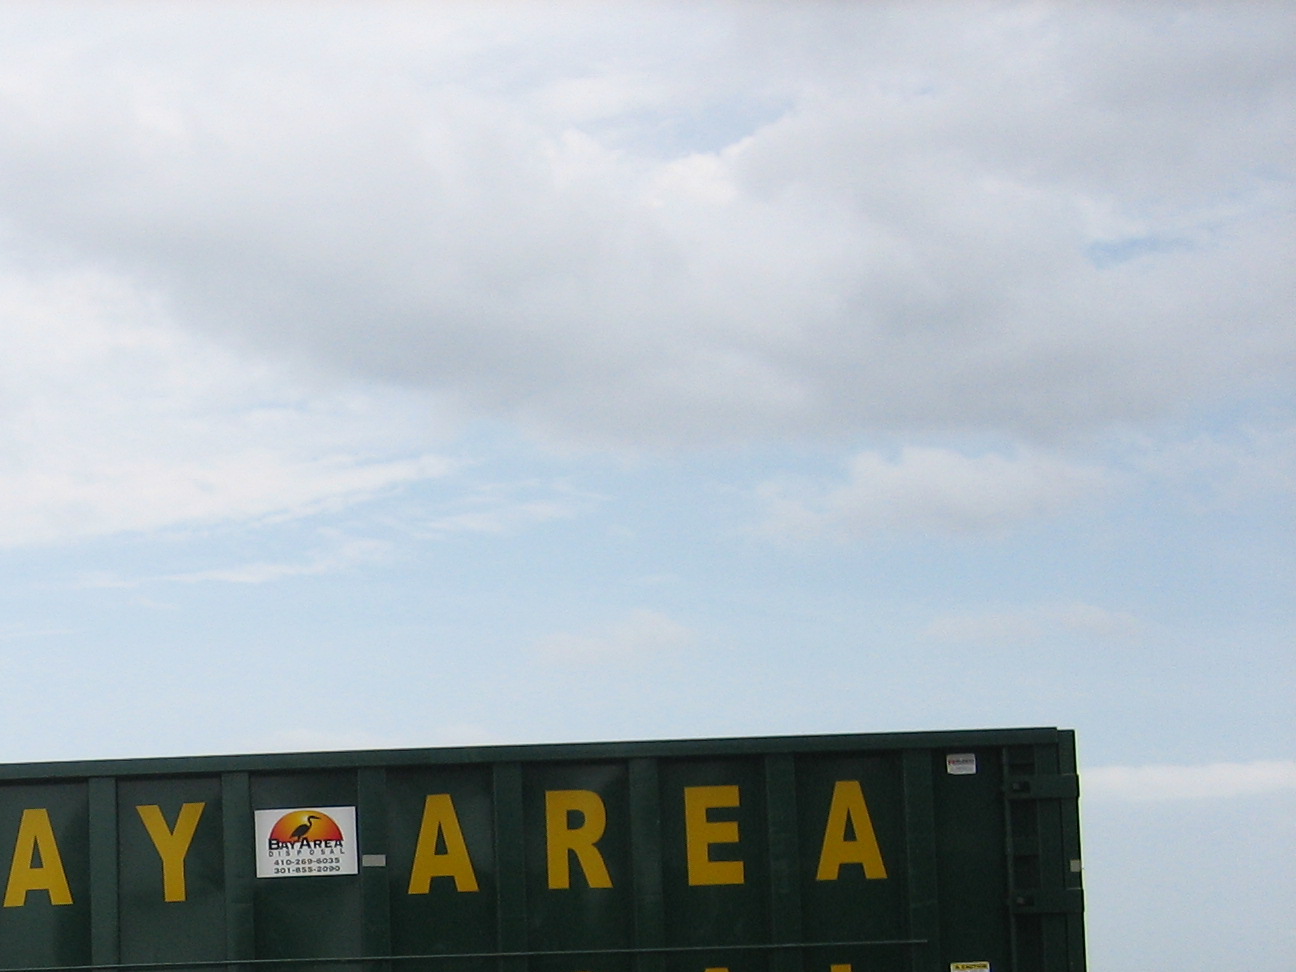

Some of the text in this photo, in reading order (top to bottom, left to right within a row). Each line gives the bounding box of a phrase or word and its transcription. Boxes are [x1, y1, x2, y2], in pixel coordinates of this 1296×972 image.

[407, 780, 888, 894] AREA
[268, 837, 343, 850] BAY AREA
[268, 848, 345, 857] DISPOSAL
[274, 857, 340, 866] 410-269-6035
[274, 866, 341, 874] 301-855-2090
